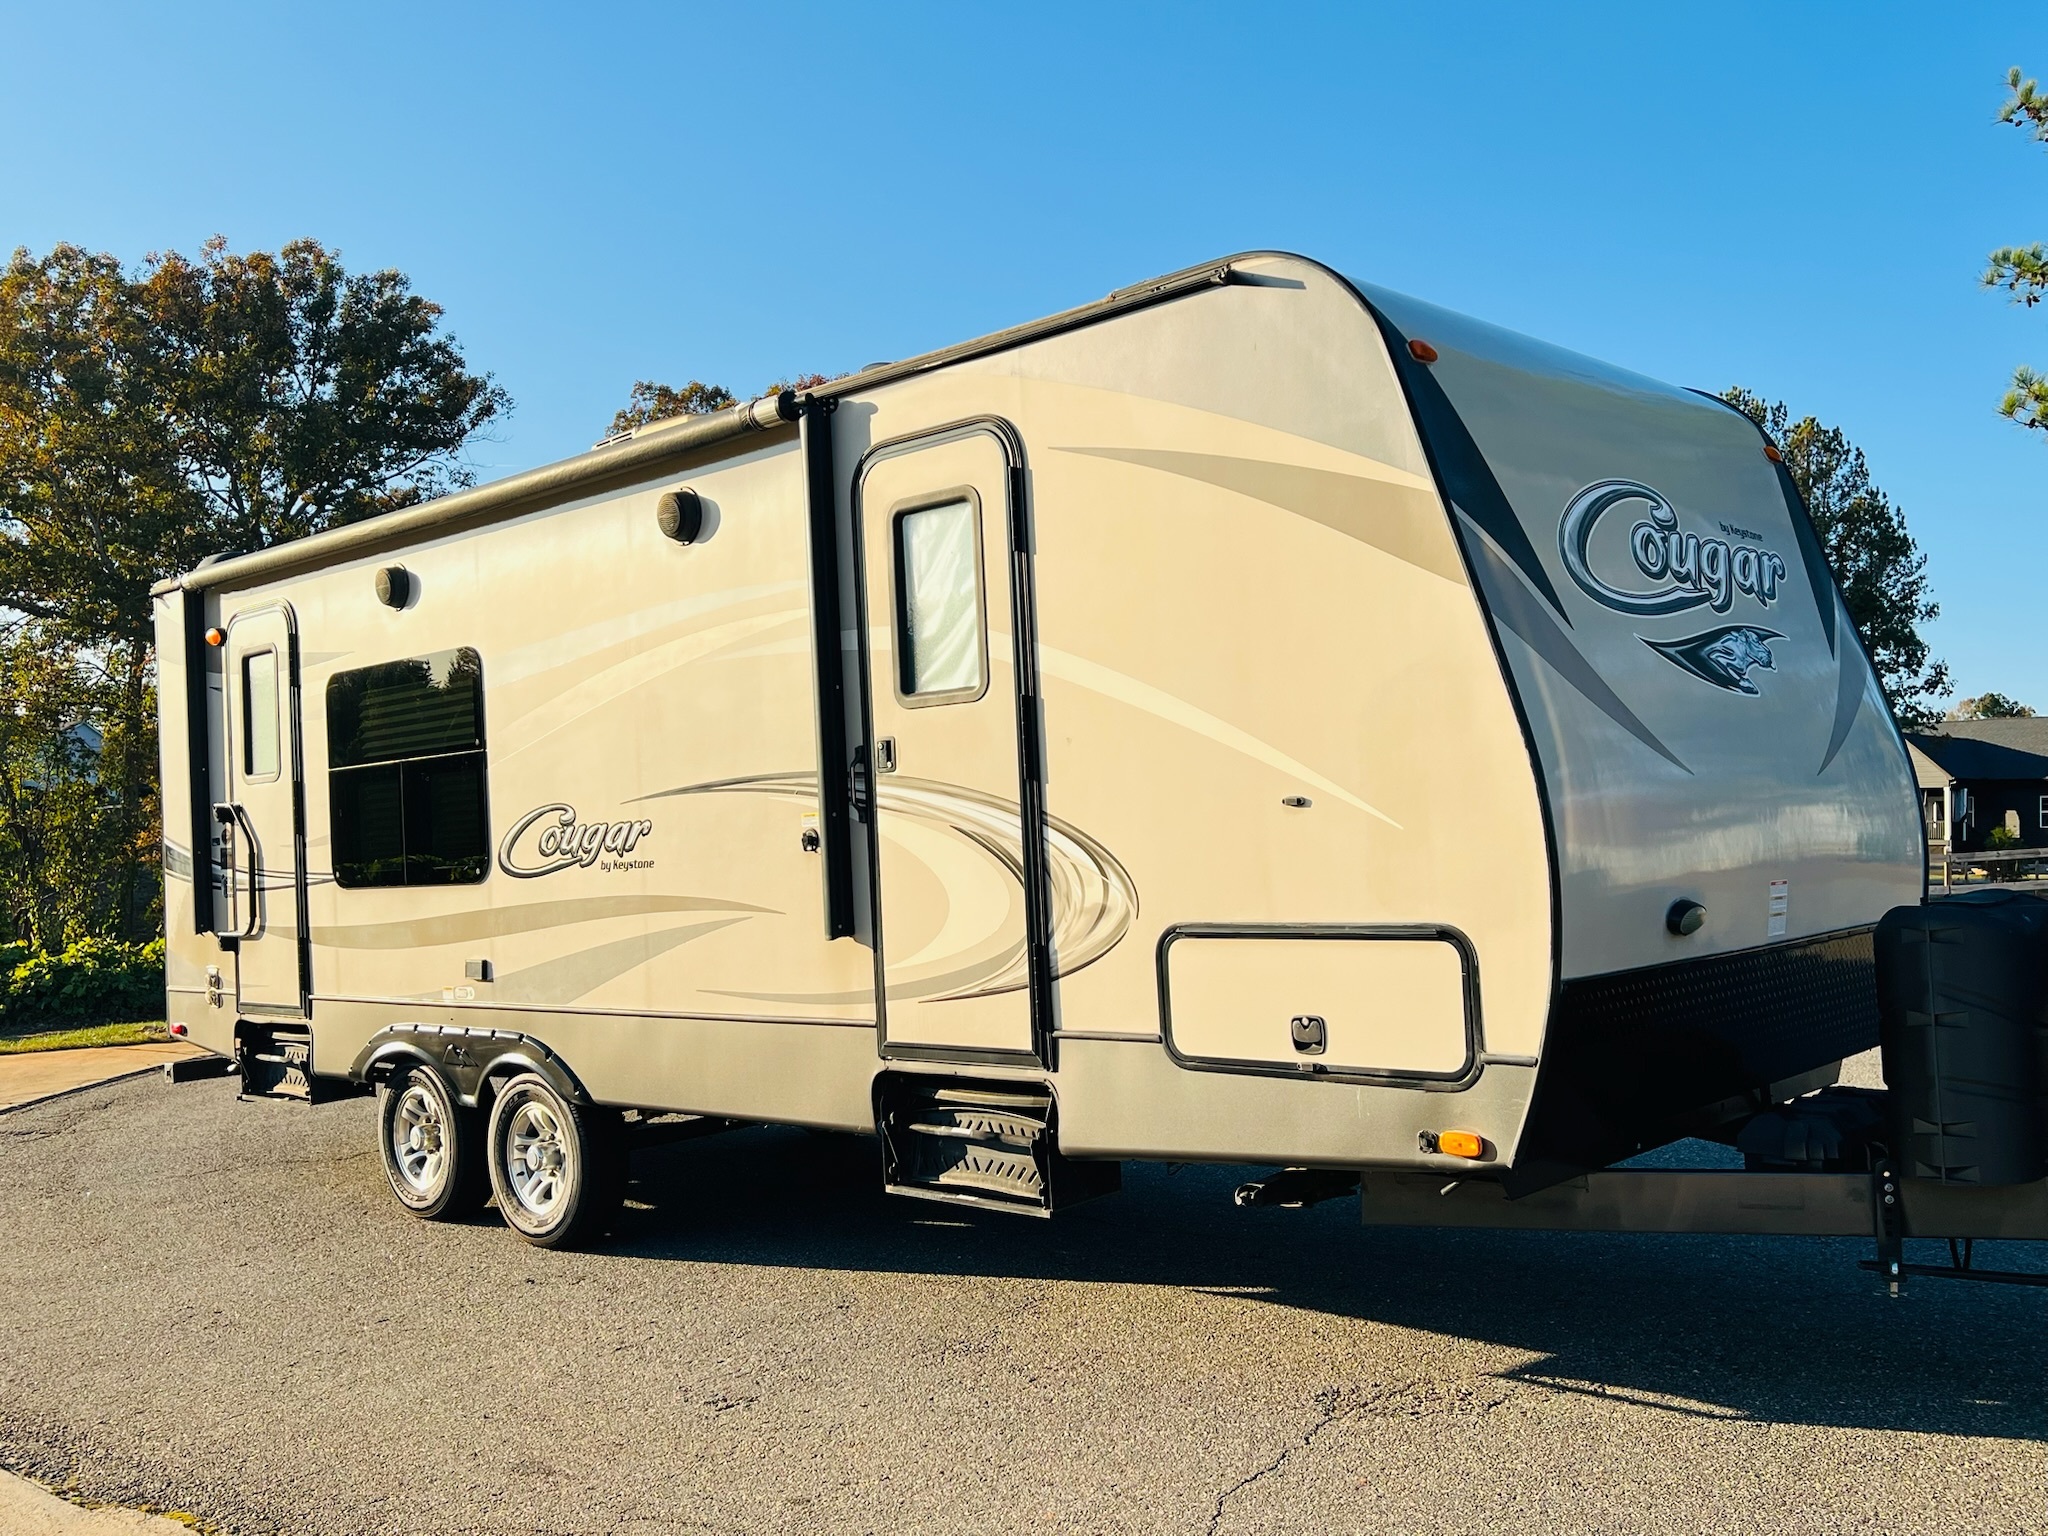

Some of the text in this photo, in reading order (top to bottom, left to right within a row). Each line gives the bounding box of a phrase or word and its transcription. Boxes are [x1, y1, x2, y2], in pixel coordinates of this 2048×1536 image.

[1557, 477, 1788, 619] Cougar
[498, 802, 652, 879] Cougar
[600, 858, 655, 873] by Keystone
